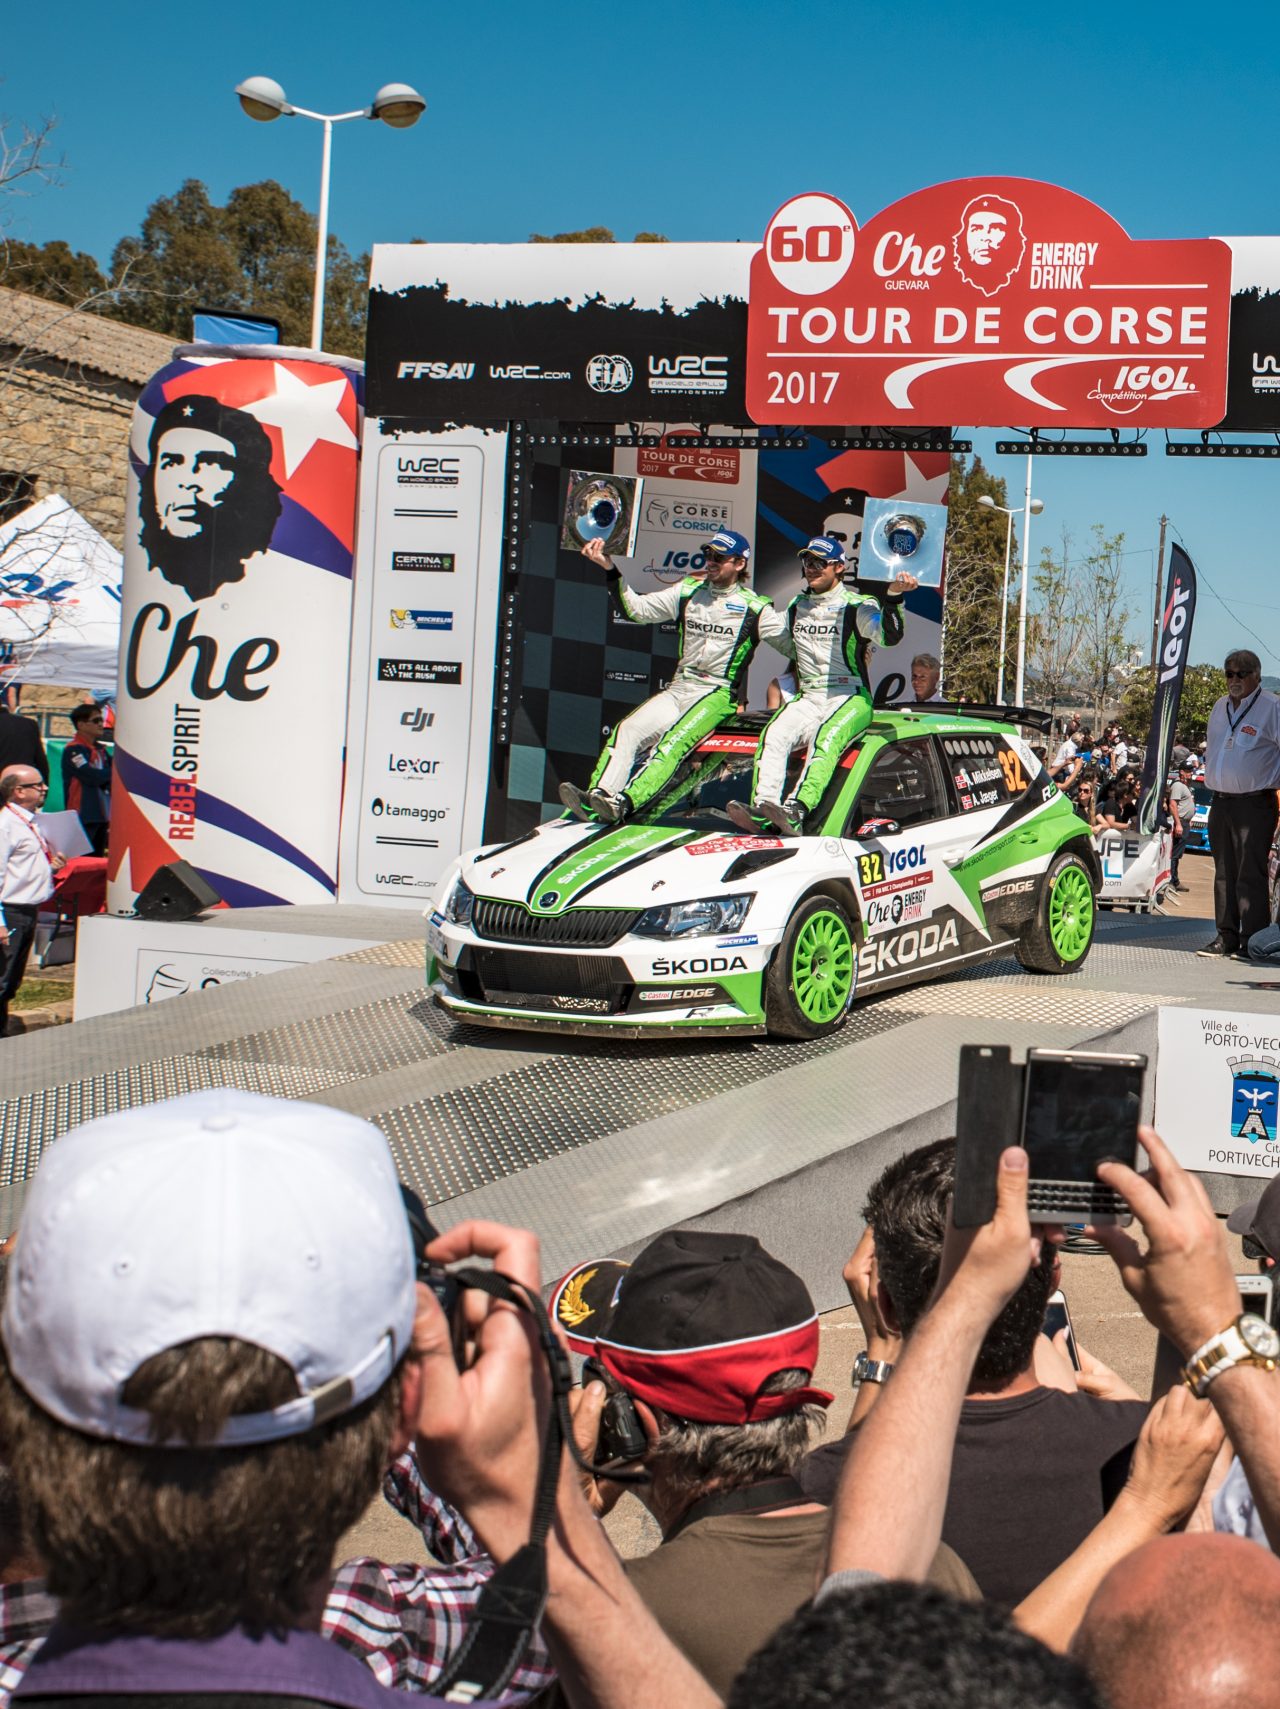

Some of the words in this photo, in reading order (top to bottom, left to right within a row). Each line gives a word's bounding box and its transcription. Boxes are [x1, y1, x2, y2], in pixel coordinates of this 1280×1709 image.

[873, 231, 946, 277] Che
[1031, 243, 1098, 266] ENERGY
[885, 280, 930, 291] GUEVARA
[1029, 266, 1084, 289] DRINK
[768, 307, 911, 344] TOUR
[934, 307, 1000, 344] DE
[1024, 306, 1208, 345] CORSE
[648, 355, 728, 376] WRC
[767, 372, 840, 404] 2017
[1087, 388, 1147, 403] Compétition
[398, 457, 460, 473] WRC
[642, 464, 659, 472] 2017
[643, 451, 676, 462] TOUR
[679, 454, 694, 463] DE
[699, 457, 736, 468] CORSE
[673, 505, 728, 519] CORSE
[672, 520, 726, 532] CORSICA
[395, 555, 441, 564] CERTINA
[663, 551, 708, 569] IGO
[416, 616, 452, 625] MICHELIN
[126, 602, 280, 702] Che
[415, 664, 430, 672] ALL
[432, 665, 457, 673] ABOUT
[415, 672, 435, 680] RUSH
[168, 703, 201, 840] REBELSPIRIT
[389, 753, 440, 774] Lexar
[998, 750, 1028, 791] 32
[972, 768, 1002, 784] Mikkelsen
[1042, 781, 1057, 802] R5
[890, 844, 927, 874] IGOL
[861, 853, 882, 884] 32
[1000, 880, 1035, 897] EDGE
[904, 889, 927, 907] ENERGY
[867, 901, 890, 926] Che
[904, 904, 922, 921] DRINK
[652, 956, 748, 976] ŠKODA
[647, 991, 670, 1000] Castrol
[672, 988, 716, 999] EDGE
[1201, 1020, 1222, 1031] Ville
[1225, 1022, 1238, 1032] de
